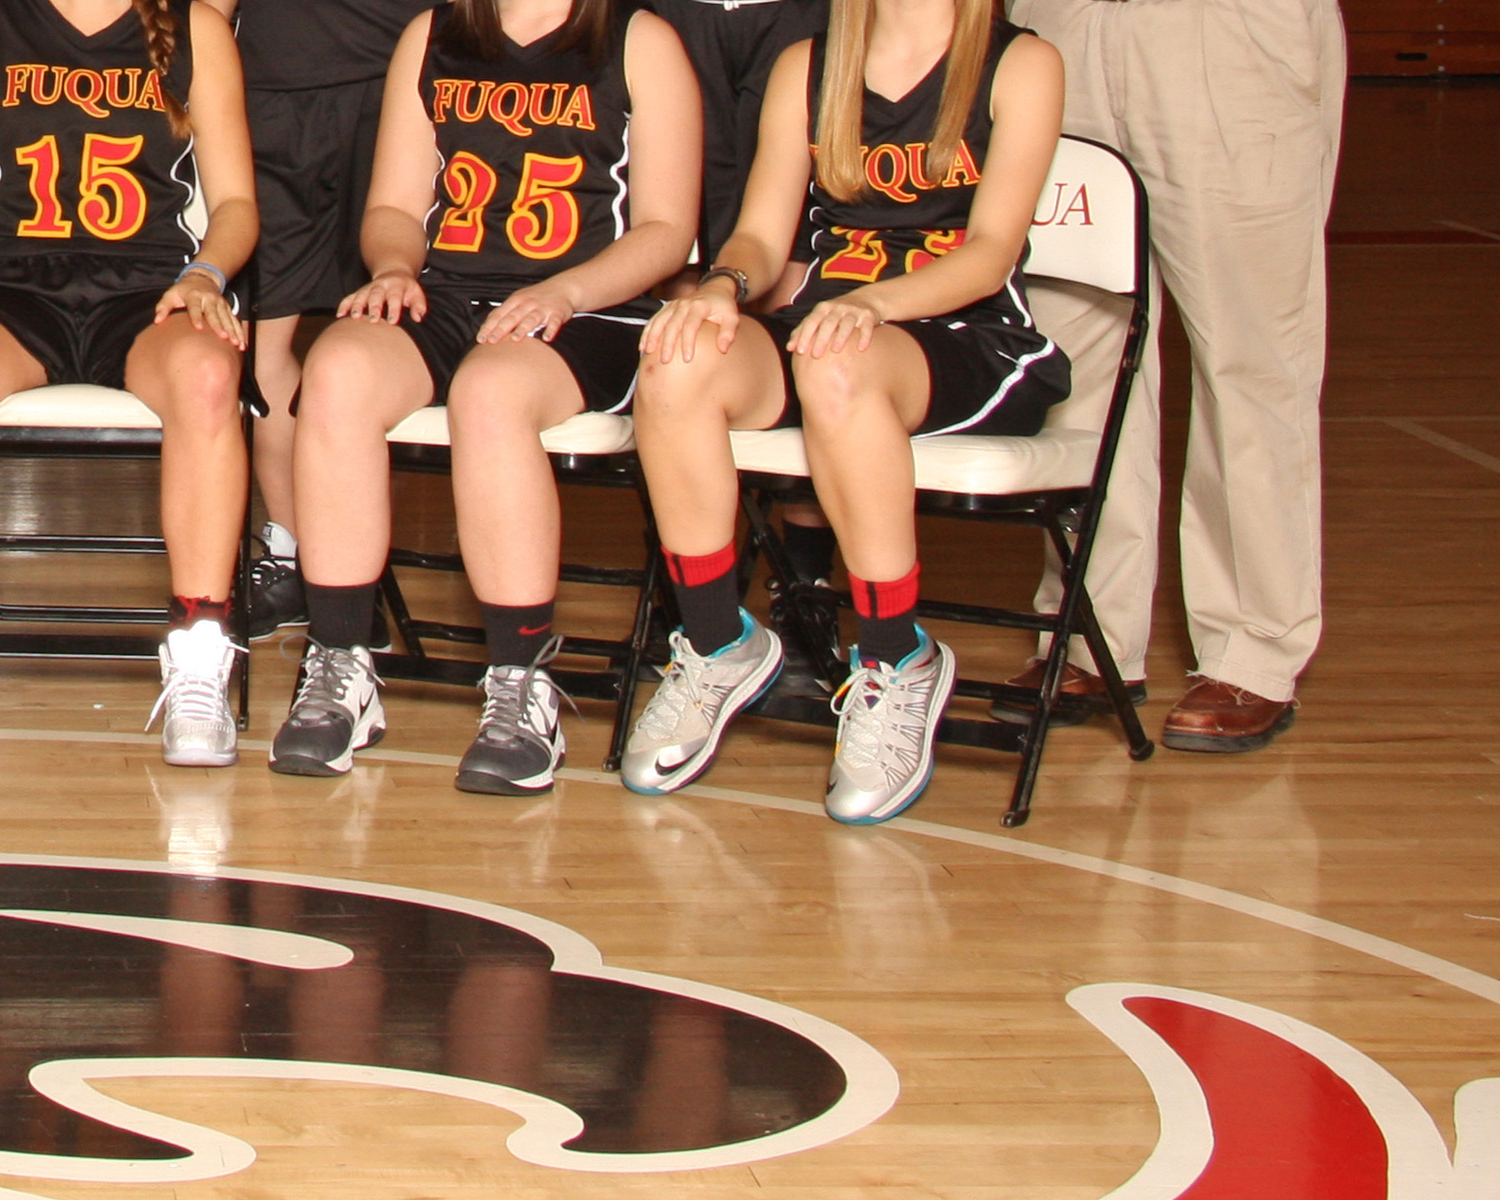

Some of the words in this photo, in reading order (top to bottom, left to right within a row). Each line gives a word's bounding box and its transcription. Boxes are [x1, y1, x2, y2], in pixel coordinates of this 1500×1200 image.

[2, 64, 167, 118] FUQUA
[433, 78, 596, 137] FUQUA
[15, 133, 147, 240] 15
[432, 150, 583, 260] 25
